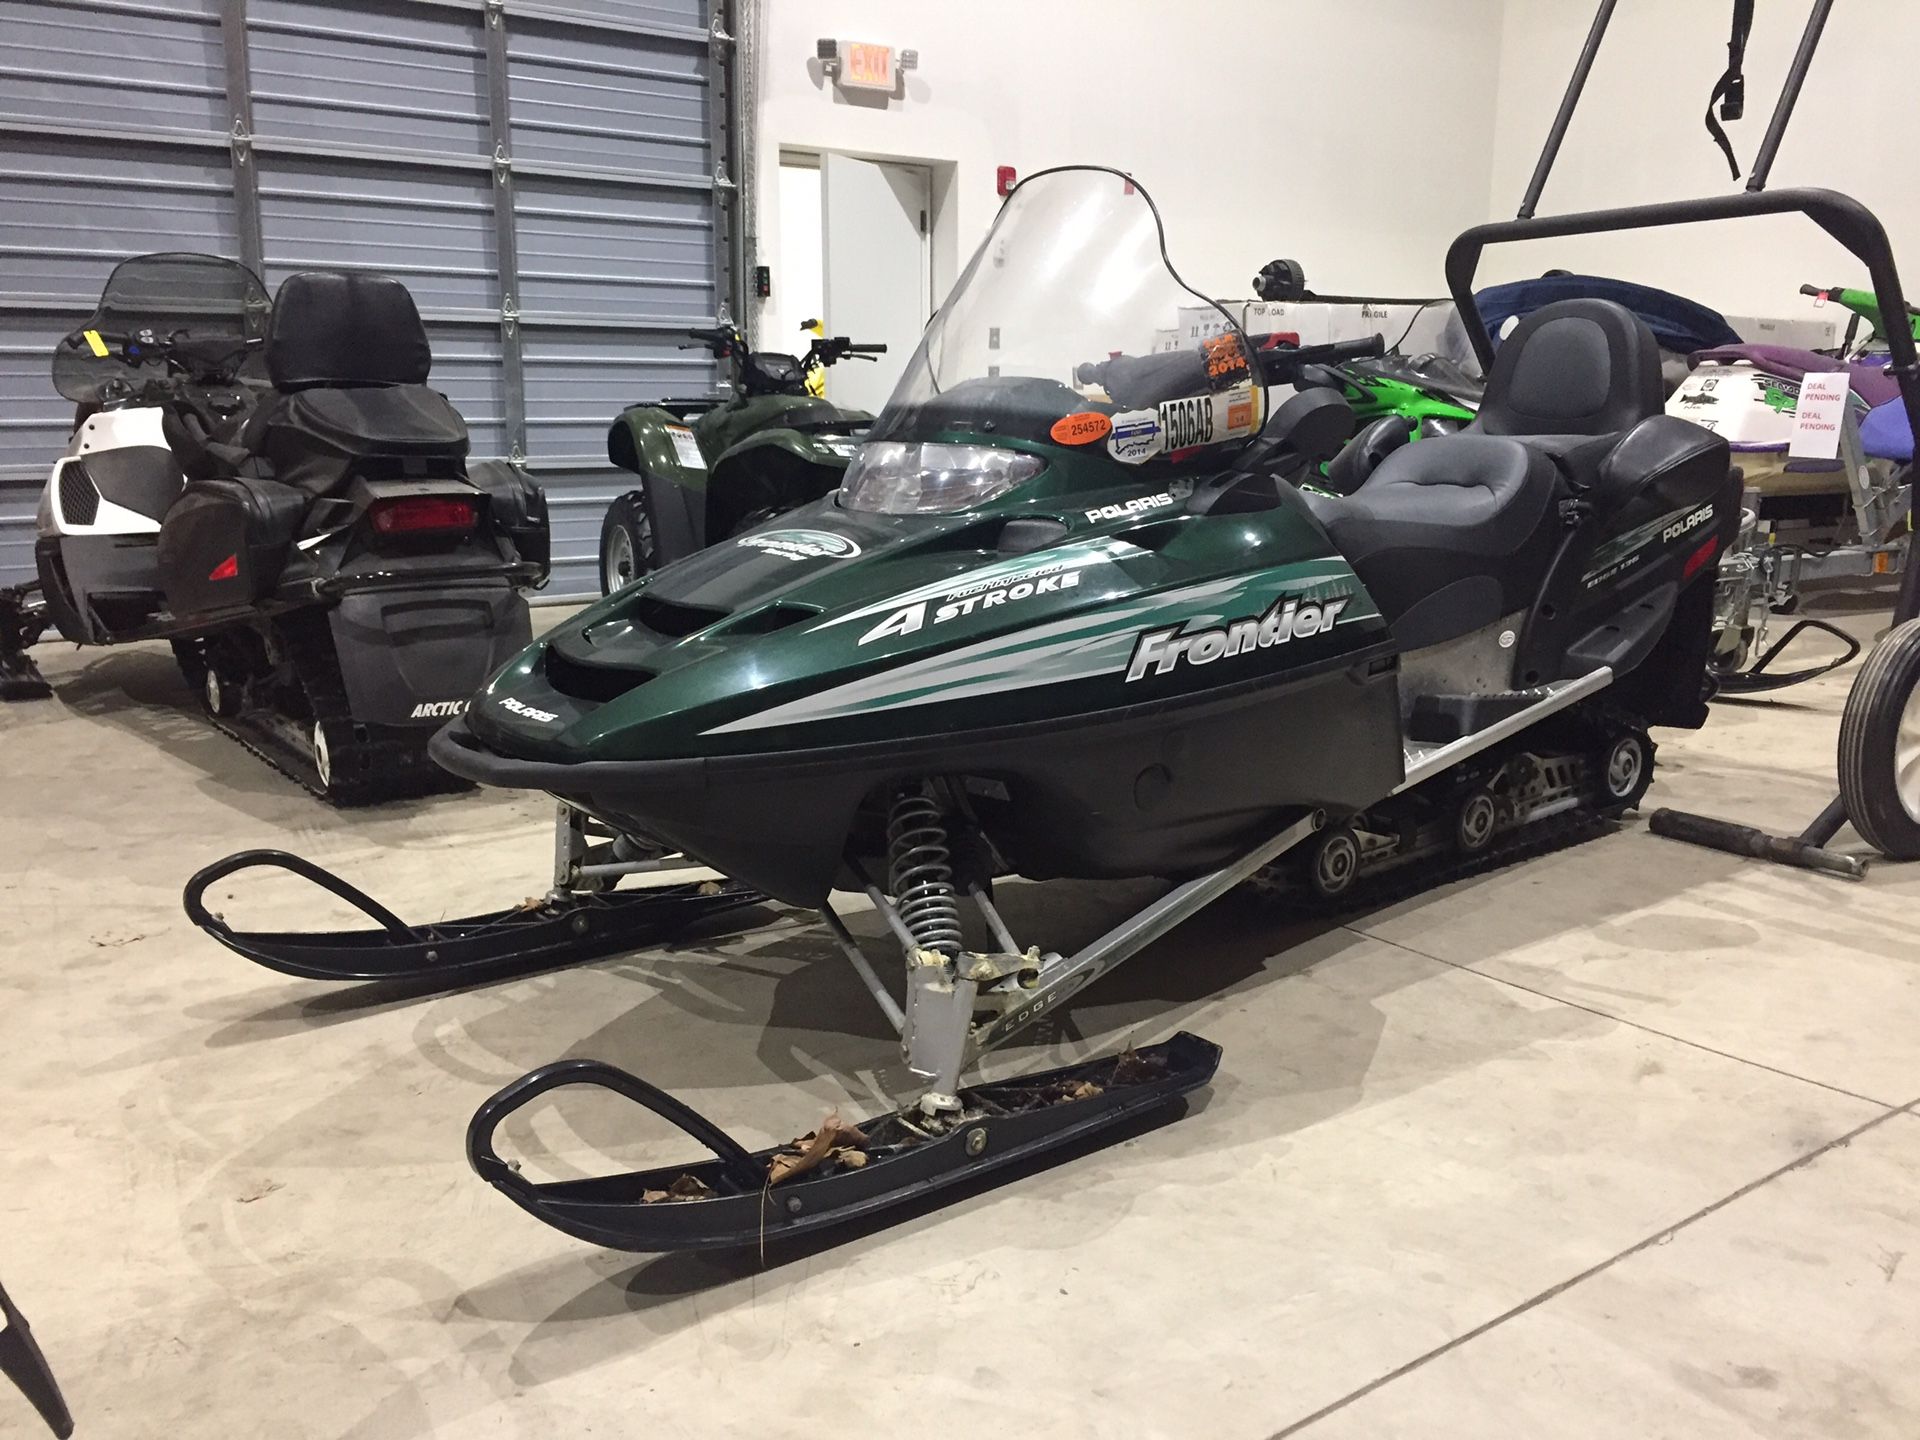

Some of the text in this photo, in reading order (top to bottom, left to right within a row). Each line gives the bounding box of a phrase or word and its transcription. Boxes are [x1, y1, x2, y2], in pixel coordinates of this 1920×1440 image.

[850, 44, 889, 81] EXIT
[1253, 307, 1285, 316] TOP OAD
[1208, 356, 1246, 378] 2014
[1804, 393, 1841, 402] PENDING
[1807, 382, 1826, 391] DEAL
[1161, 397, 1213, 451] 1506AB
[1799, 422, 1836, 431] PENDING
[1801, 412, 1821, 420] DEAL
[1071, 419, 1106, 436] 254572
[1127, 447, 1147, 457] 2014
[1084, 492, 1174, 524] POLARIS
[1662, 503, 1714, 544] POLARIS
[932, 570, 1082, 625] STROKE
[1124, 598, 1349, 684] Frontier
[410, 700, 464, 718] ARCTIC
[498, 697, 559, 723] POLARIS
[1005, 991, 1057, 1032] EDGE
